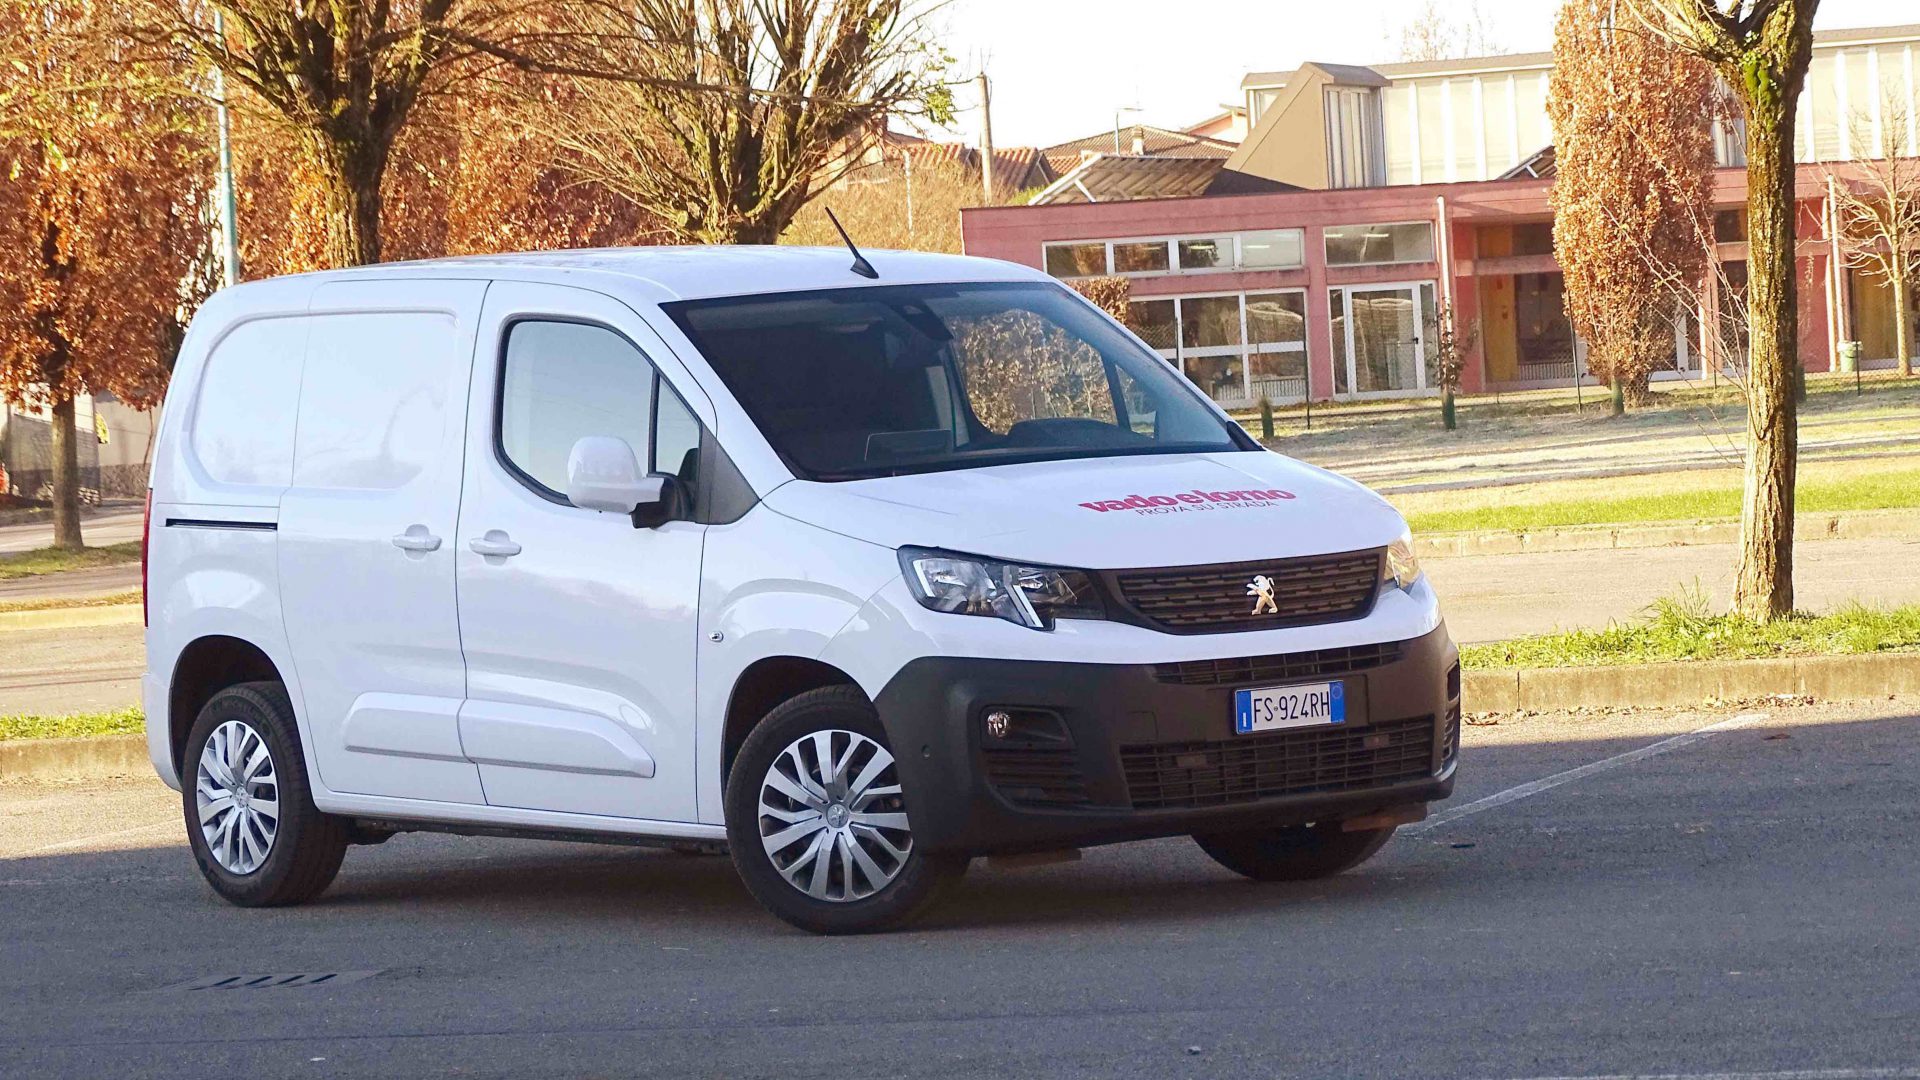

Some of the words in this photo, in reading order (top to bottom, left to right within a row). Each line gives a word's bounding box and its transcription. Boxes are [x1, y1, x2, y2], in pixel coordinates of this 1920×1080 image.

[1135, 505, 1192, 516] PROVA
[1197, 503, 1215, 511] SU
[1221, 500, 1279, 510] STRADA
